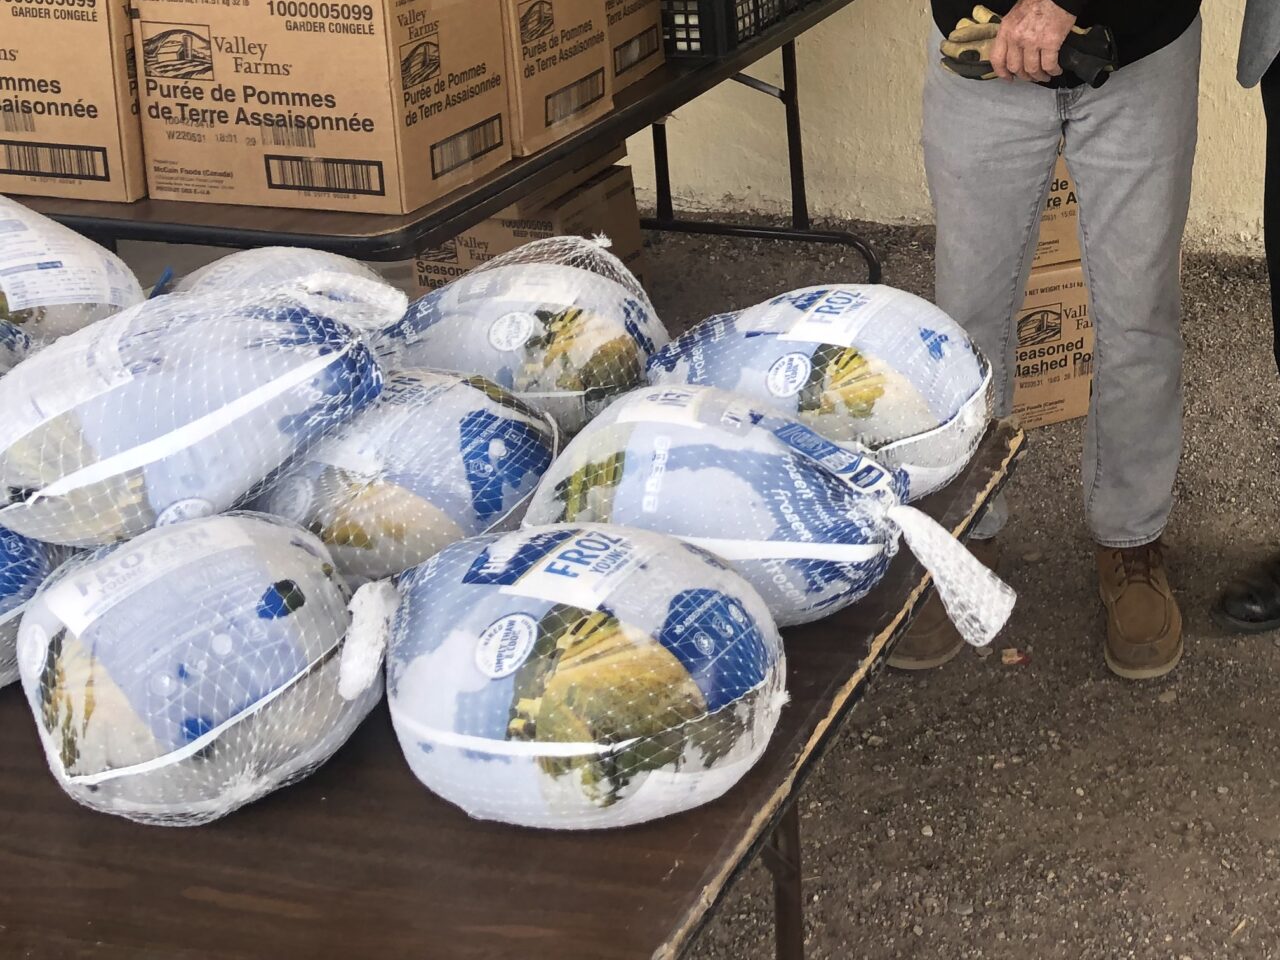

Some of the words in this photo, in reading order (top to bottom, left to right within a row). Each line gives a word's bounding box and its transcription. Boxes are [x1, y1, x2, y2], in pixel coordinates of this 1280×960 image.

[11, 6, 50, 19] GARDER
[53, 8, 98, 22] CONGELÉ
[266, 0, 373, 21] 1000005099
[397, 8, 427, 28] Valley
[285, 20, 326, 33] GARDER
[329, 21, 375, 35] CONGELÉ
[408, 20, 439, 40] Farms
[548, 33, 559, 49] de
[560, 19, 592, 44] Pommes
[212, 36, 268, 61] Valley
[233, 56, 291, 76] Farms
[524, 61, 536, 78] de
[536, 53, 557, 72] Terre
[145, 78, 204, 101] Purée
[210, 83, 236, 102] de
[243, 85, 336, 108] Pommes
[403, 86, 431, 108] Purée
[433, 78, 445, 93] de
[448, 61, 487, 88] Pommes
[405, 110, 417, 127] de
[417, 101, 443, 122] Terre
[445, 72, 501, 112] Assaisonnée
[147, 101, 172, 120] de
[175, 103, 229, 124] Terre
[235, 106, 375, 133] Assaisonnée
[1050, 178, 1069, 192] de
[457, 236, 489, 252] Valley
[1063, 304, 1087, 320] Vall
[772, 489, 813, 541] frozen
[544, 531, 623, 578] FROZ
